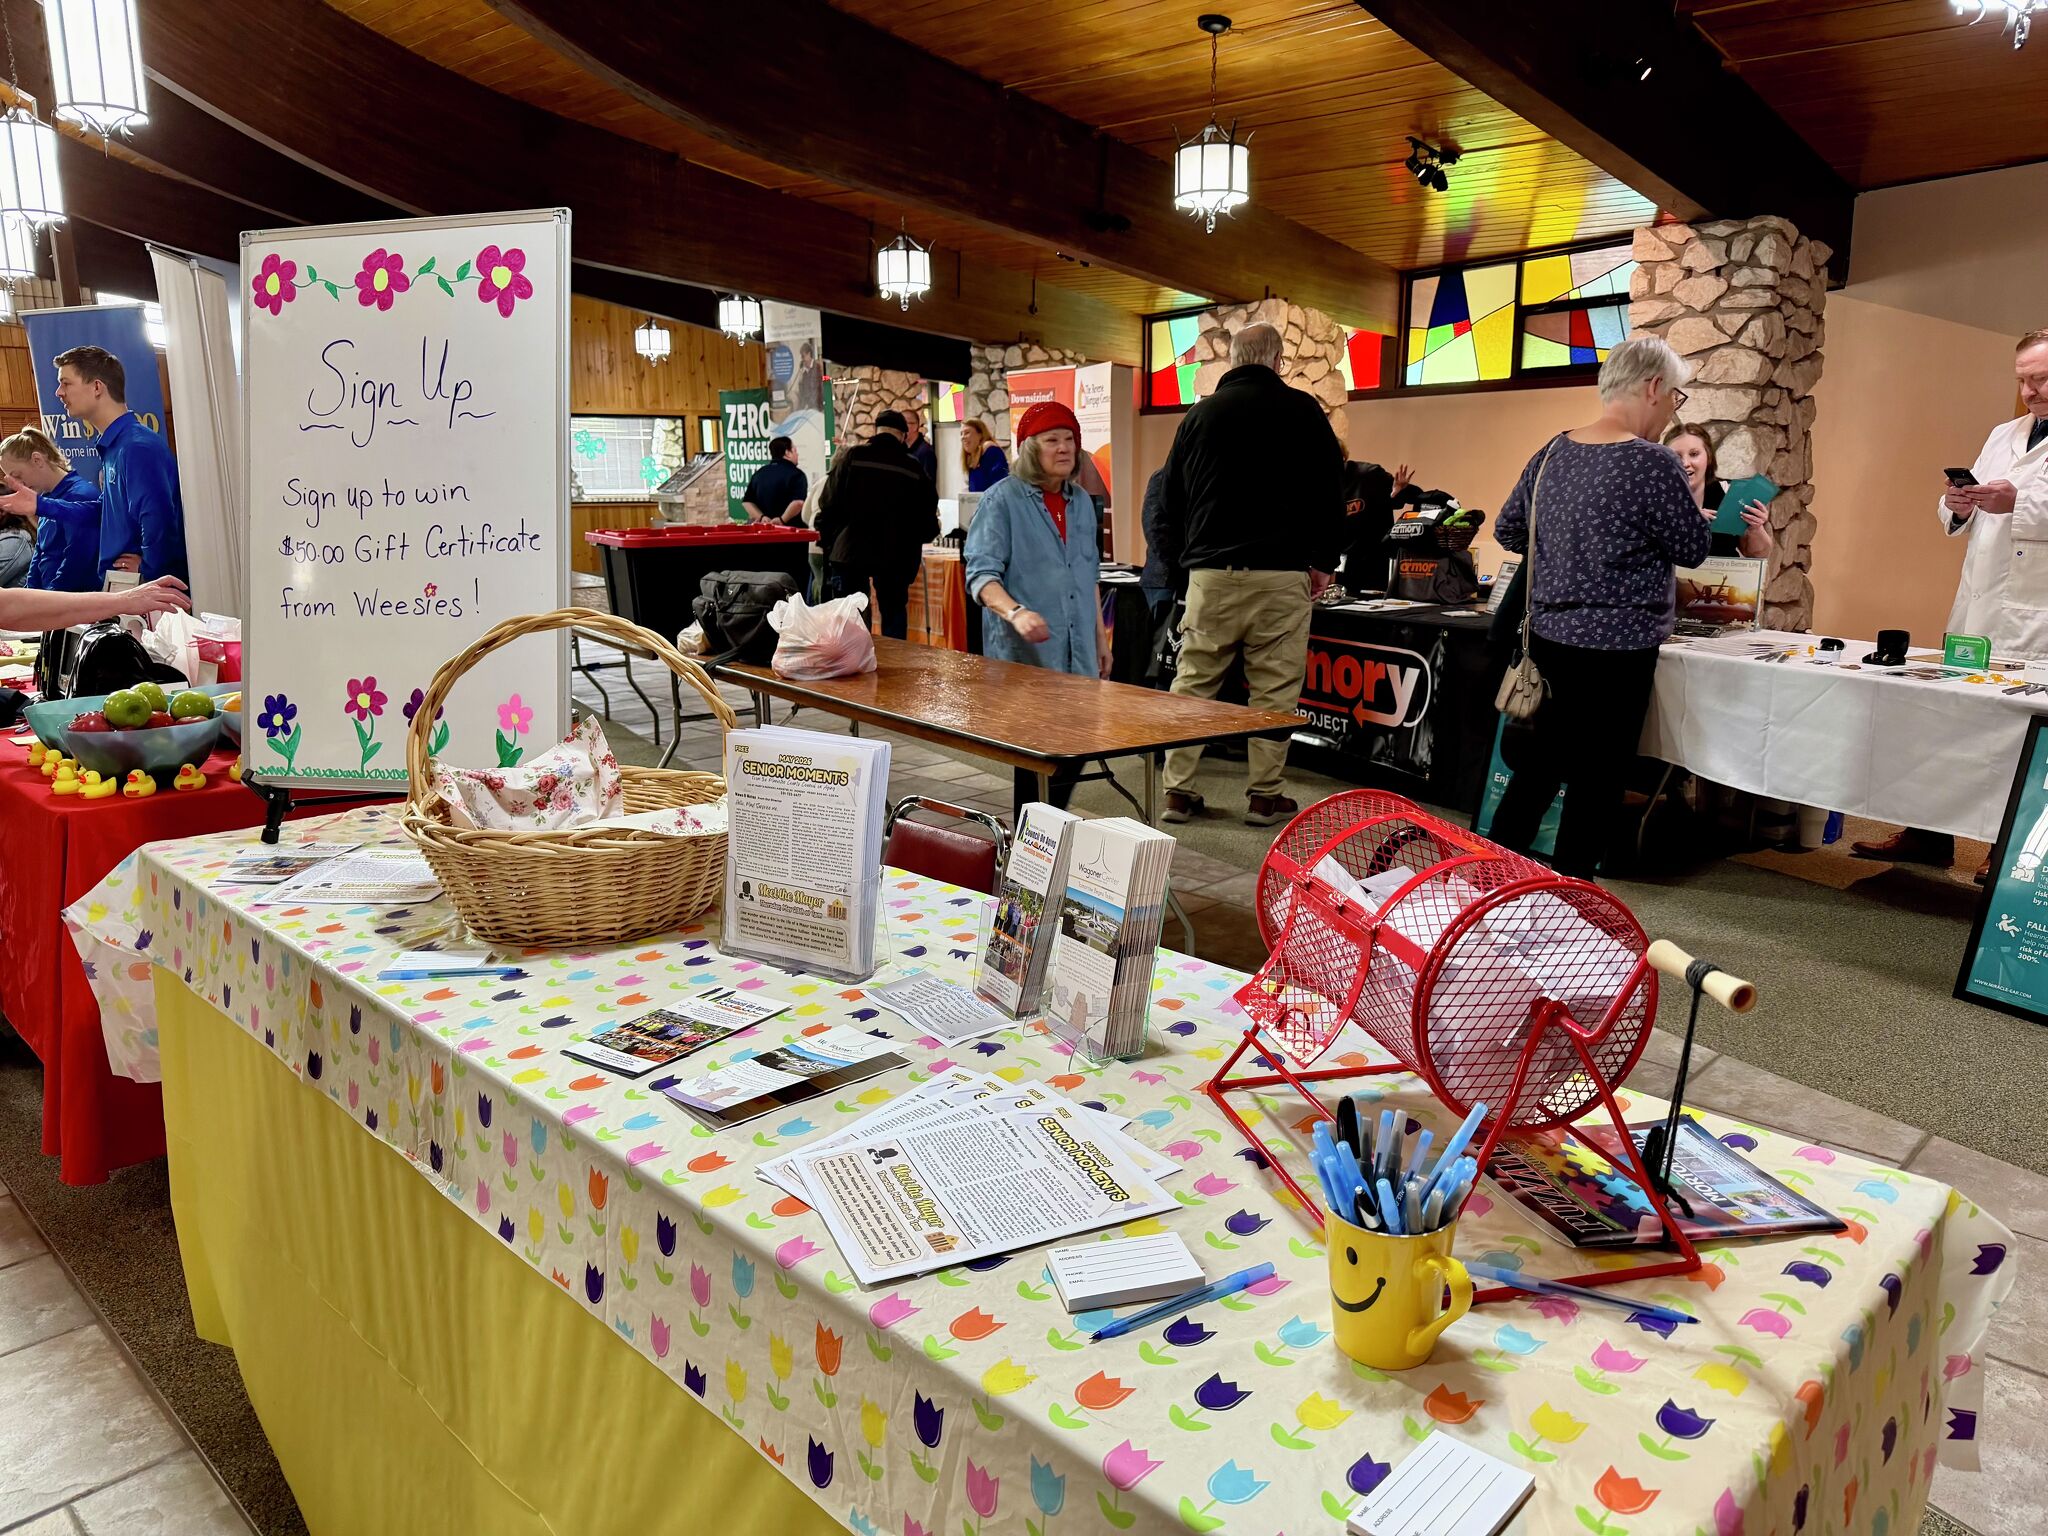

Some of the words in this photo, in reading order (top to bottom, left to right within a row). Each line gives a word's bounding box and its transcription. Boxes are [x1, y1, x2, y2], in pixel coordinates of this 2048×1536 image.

[307, 339, 402, 448] Sign
[422, 336, 473, 429] Up
[42, 414, 82, 439] Win
[725, 402, 770, 439] ZERO
[282, 478, 336, 528] Sign
[347, 487, 373, 520] up
[382, 478, 405, 507] to
[415, 484, 470, 505] win
[1391, 523, 1422, 537] armory
[278, 535, 344, 564] $50.00
[355, 532, 410, 562] Gift
[426, 518, 541, 559] Certificate
[280, 587, 335, 619] from
[734, 745, 749, 753] FREE
[779, 754, 794, 764] MAY
[743, 760, 785, 778] SENIOR
[785, 765, 849, 787] MOMENTS
[758, 883, 779, 899] Meet
[779, 886, 794, 902] the
[793, 888, 825, 910] Mayor
[2019, 946, 2033, 954] risk
[1055, 1106, 1072, 1119] FREE
[1079, 1140, 1101, 1153] MAY
[1038, 1116, 1081, 1153] SENIOR
[1068, 1148, 1131, 1204] MOMENTS
[887, 1163, 920, 1186] Meet
[889, 1191, 905, 1202] May
[900, 1182, 928, 1200] the
[907, 1196, 951, 1231] Mayor
[1058, 1254, 1083, 1262] ADDRESS
[1356, 1505, 1371, 1518] NAME
[1373, 1508, 1394, 1528] ADDRESS
